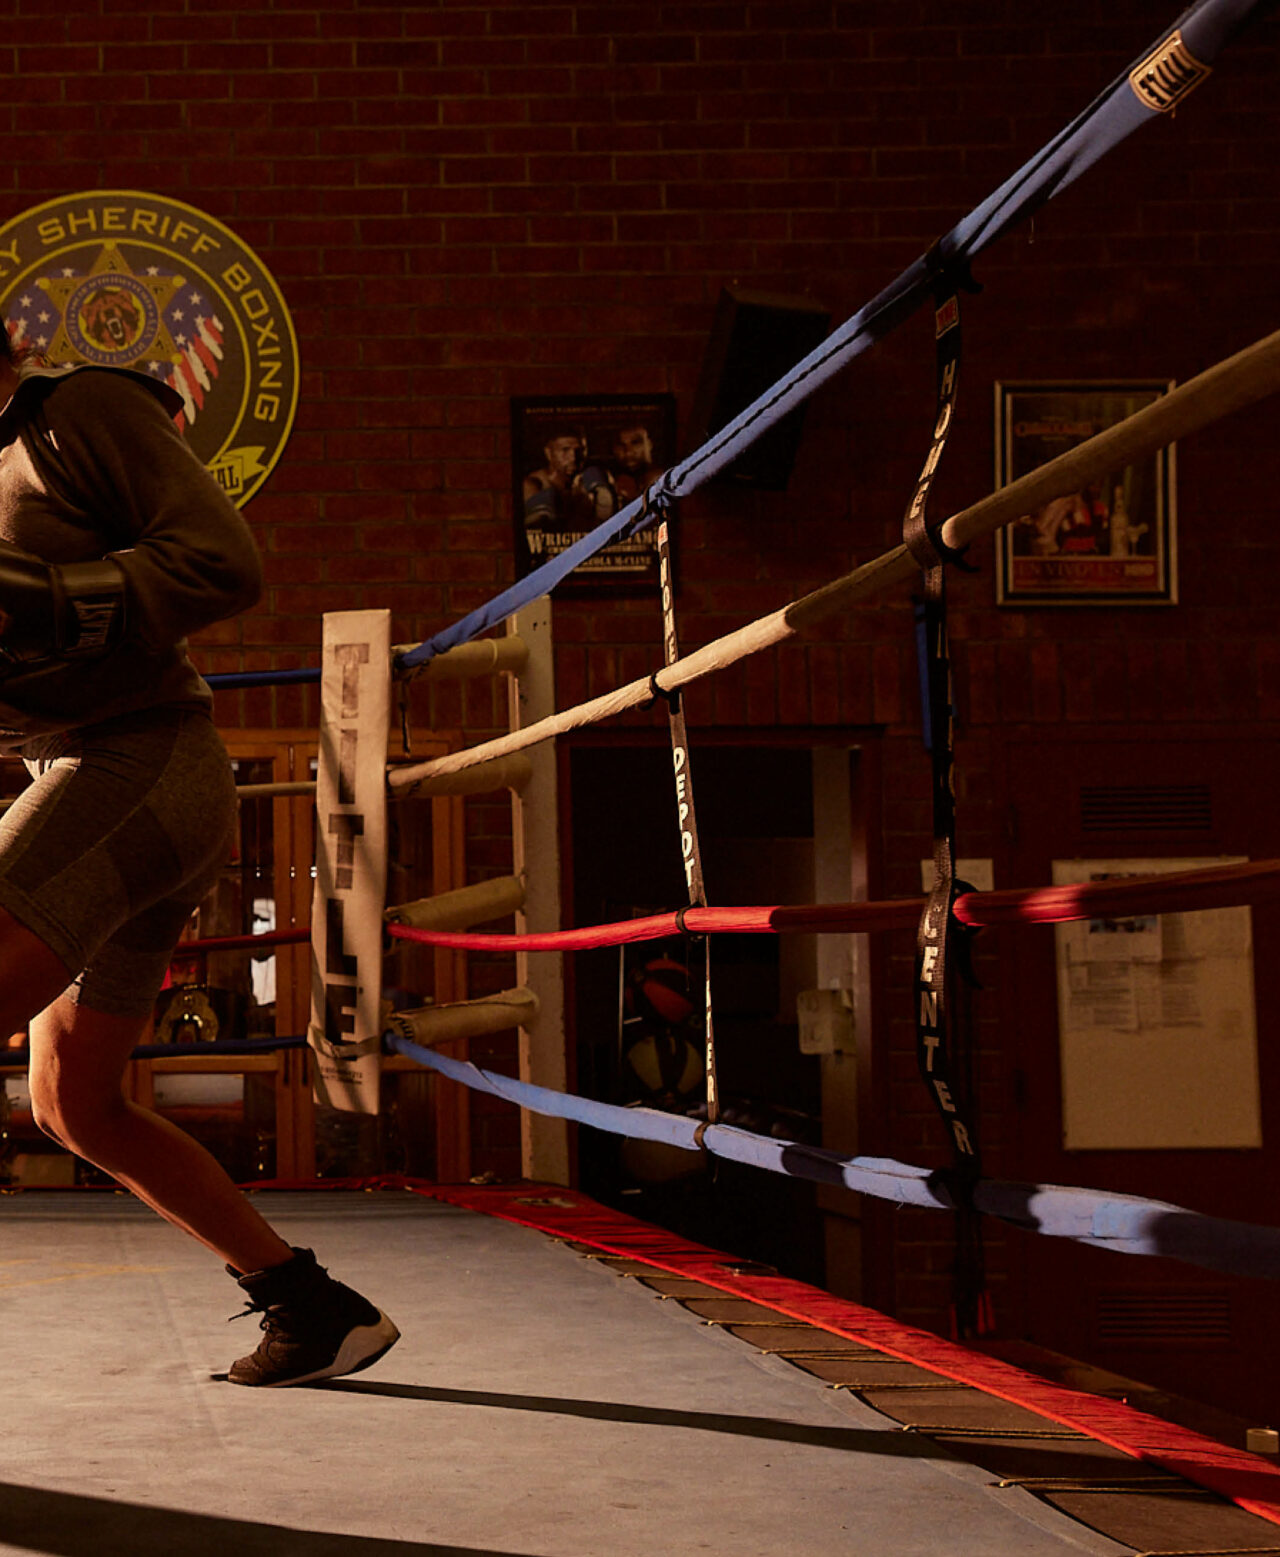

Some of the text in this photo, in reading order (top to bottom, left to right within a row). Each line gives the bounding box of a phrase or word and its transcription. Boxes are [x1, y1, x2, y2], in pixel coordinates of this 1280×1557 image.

[37, 206, 222, 255] SHERIFF
[222, 262, 284, 424] BOXING
[324, 643, 370, 1061] TITLE
[673, 746, 695, 889] DEPOT
